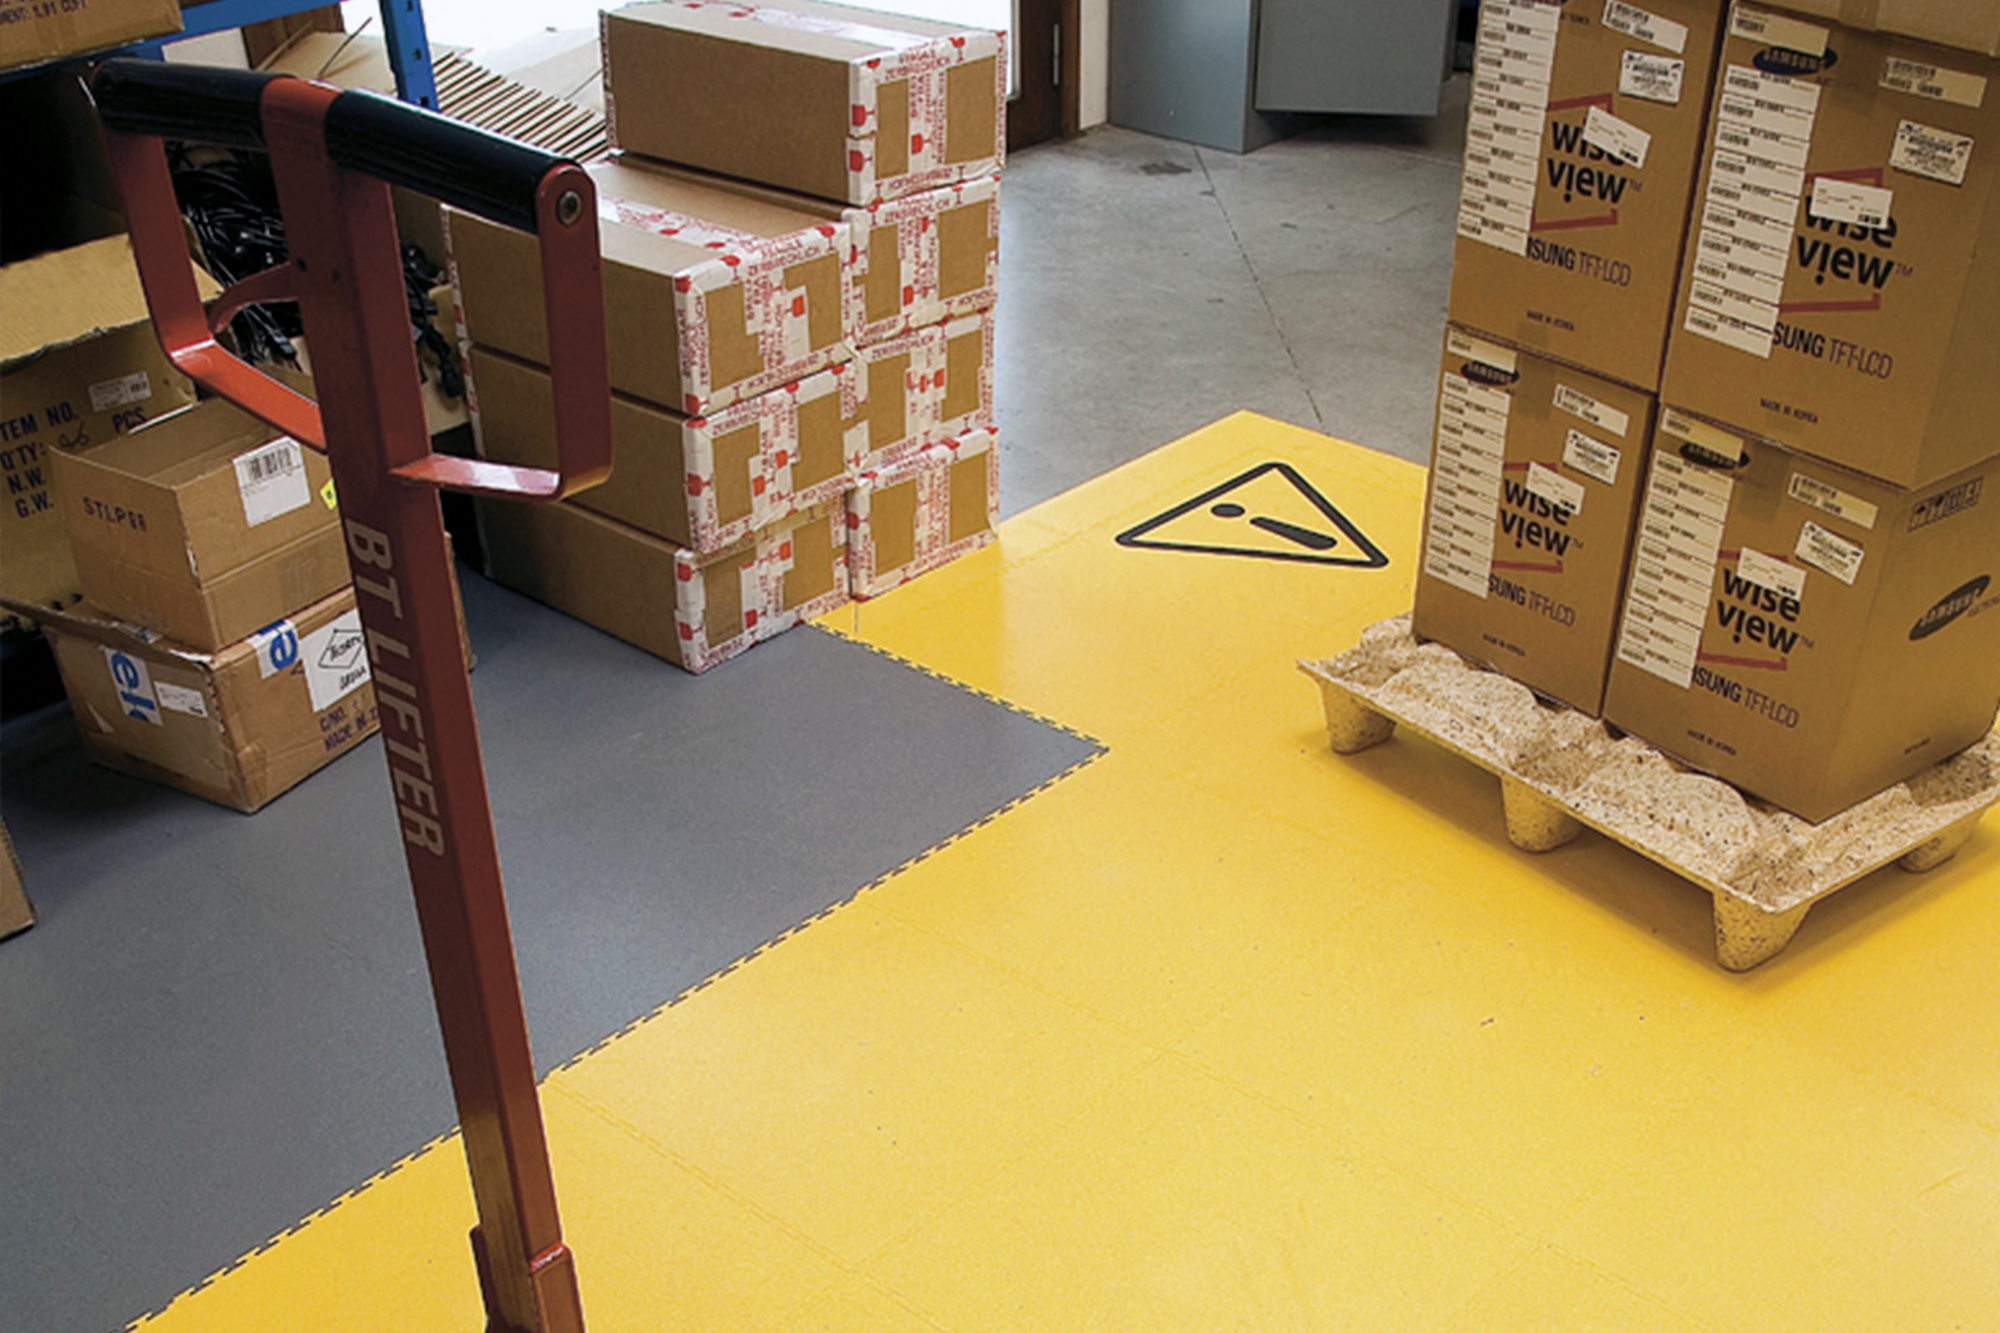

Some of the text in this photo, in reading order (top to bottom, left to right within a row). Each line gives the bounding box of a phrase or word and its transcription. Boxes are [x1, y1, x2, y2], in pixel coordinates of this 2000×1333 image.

[1548, 158, 1628, 204] view
[1579, 250, 1633, 288] TFT-LCD
[1796, 234, 1896, 291] view
[1829, 337, 1894, 381] TFT-LCD
[46, 402, 79, 427] NO.
[7, 466, 47, 495] N.W.
[15, 490, 54, 518] G.W.
[1500, 508, 1571, 557] view
[345, 518, 404, 620] BT
[1716, 598, 1799, 655] view
[1745, 687, 1800, 729] TFT-LCD
[366, 627, 445, 857] LIFTER
